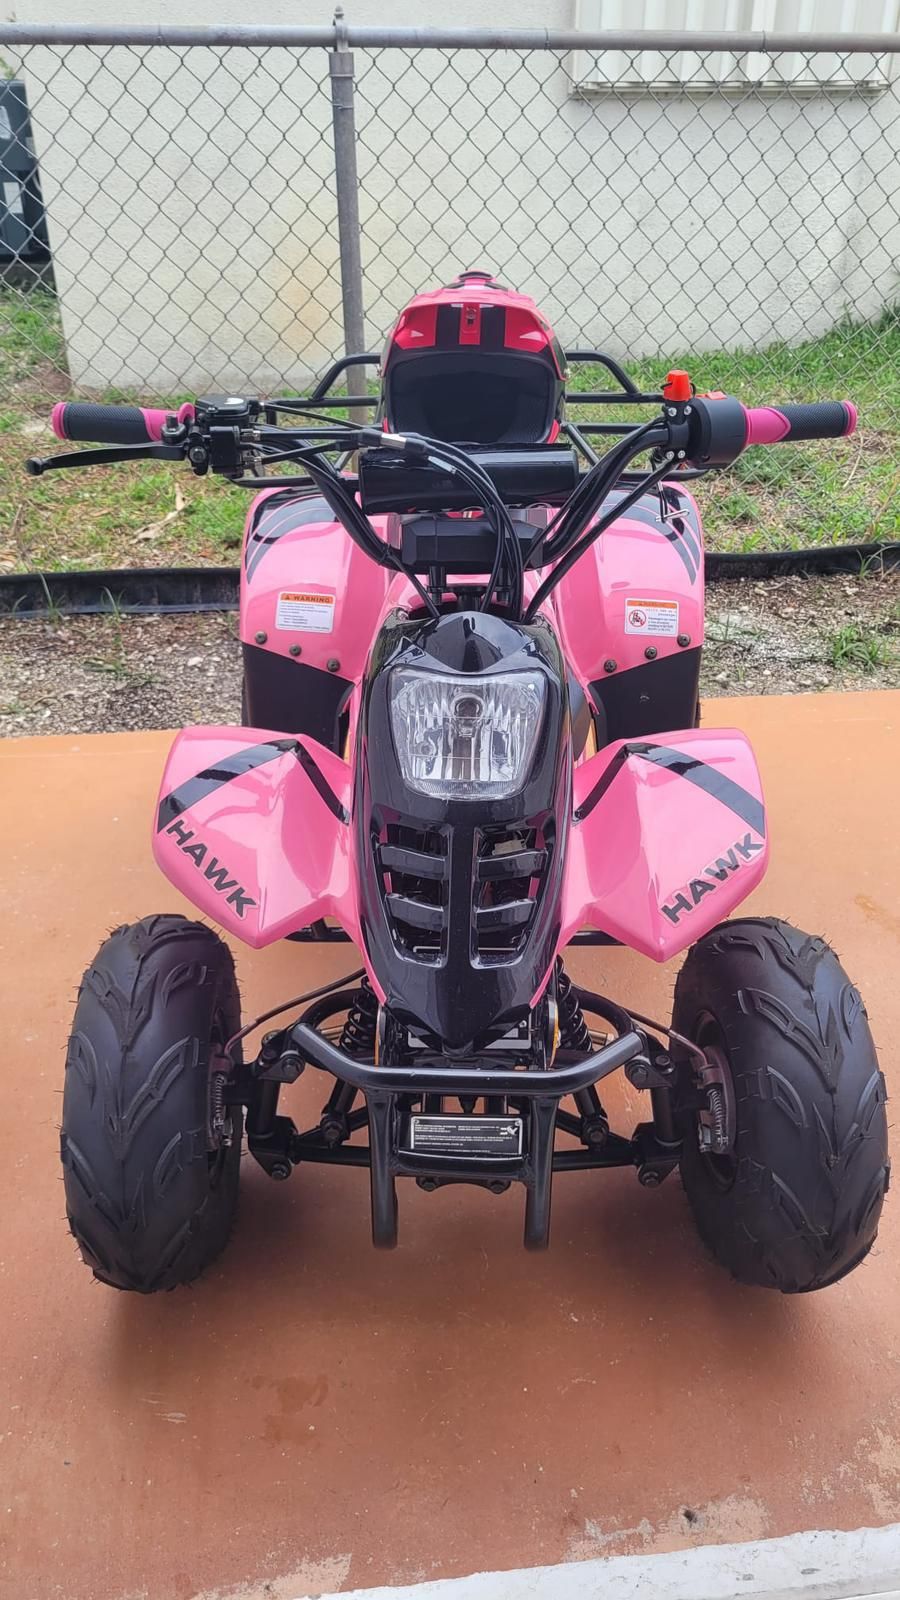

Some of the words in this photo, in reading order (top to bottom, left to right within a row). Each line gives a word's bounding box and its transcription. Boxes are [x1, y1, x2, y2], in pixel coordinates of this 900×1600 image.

[294, 595, 330, 603] WARNING
[166, 819, 257, 918] HAWK
[661, 832, 764, 924] HAWK
